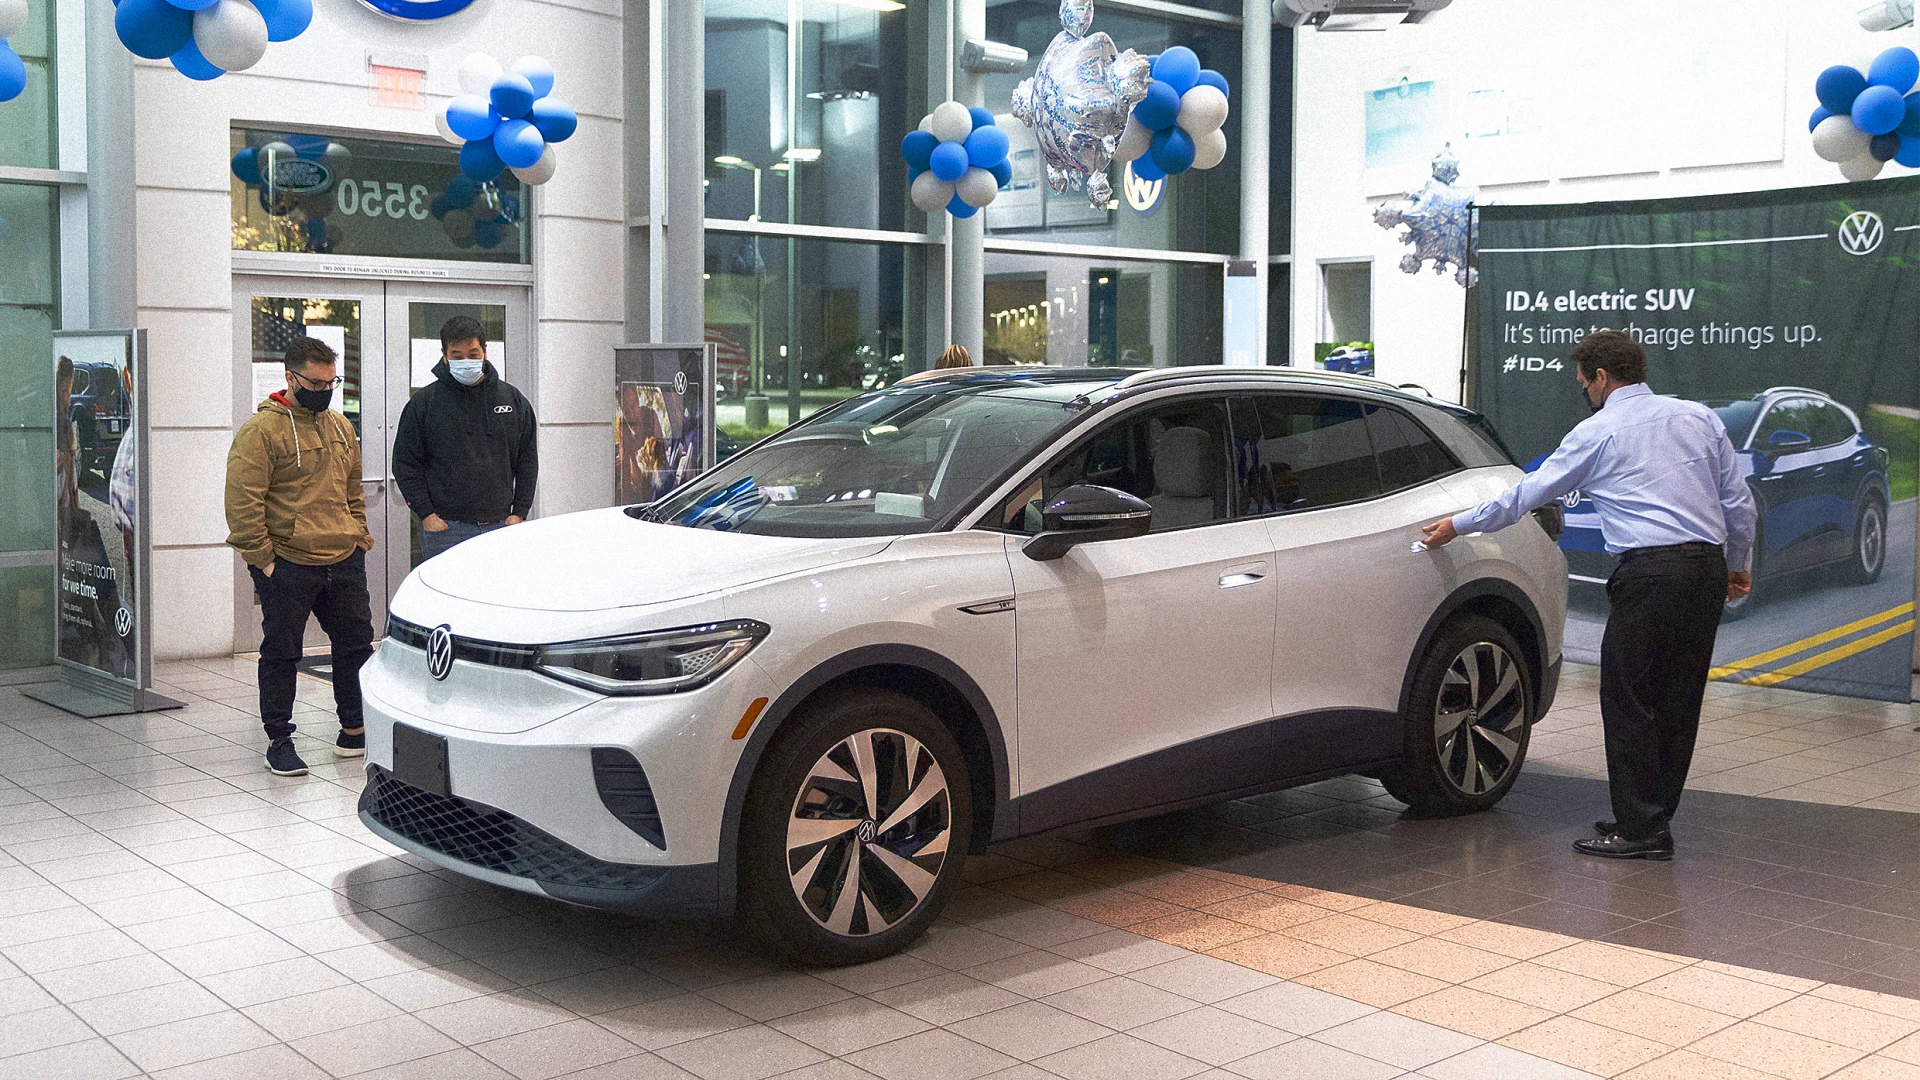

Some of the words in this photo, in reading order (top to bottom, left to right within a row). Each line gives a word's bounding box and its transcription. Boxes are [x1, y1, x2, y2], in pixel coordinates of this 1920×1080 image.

[1838, 210, 1884, 255] VW
[1505, 290, 1549, 312] ID.4
[1554, 288, 1637, 312] electric
[1644, 288, 1696, 311] SUV
[1504, 322, 1533, 344] It's
[1539, 323, 1585, 344] time
[1621, 322, 1695, 350] harge
[1700, 322, 1775, 349] things
[1784, 324, 1823, 348] up.
[1502, 354, 1564, 373] #ID4
[93, 564, 116, 580] room
[70, 580, 80, 595] we
[80, 579, 99, 600] time.
[428, 626, 451, 679] VW
